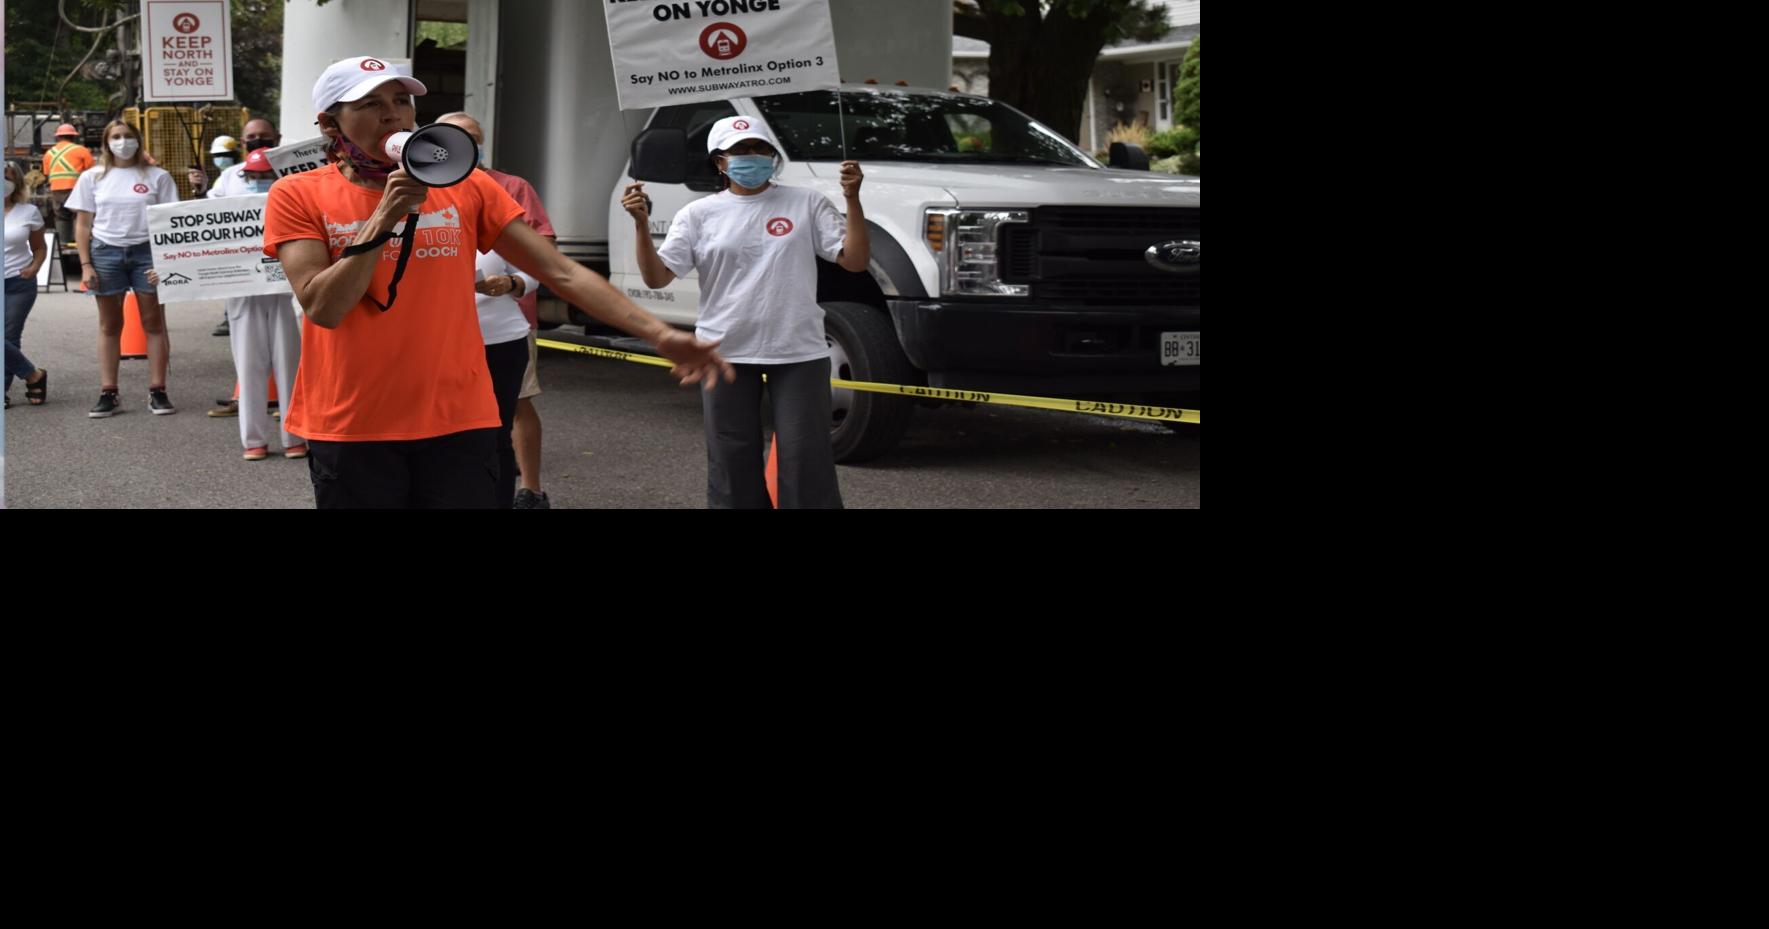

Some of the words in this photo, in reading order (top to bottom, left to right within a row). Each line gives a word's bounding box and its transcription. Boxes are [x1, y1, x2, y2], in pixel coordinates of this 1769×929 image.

[653, 4, 691, 22] ON
[699, 0, 780, 17] YONGE
[162, 36, 212, 49] KEEP
[163, 50, 213, 60] NORTH
[163, 68, 190, 77] STAY
[194, 67, 213, 76] ON
[630, 73, 654, 85] Say
[658, 71, 680, 82] NO
[684, 70, 697, 80] to
[701, 65, 763, 78] Metrolinx
[767, 60, 812, 72] Option
[816, 56, 824, 66] 3
[164, 77, 214, 86] YONGE
[668, 76, 791, 95] WWW.SUBWAYATRO.COM
[170, 215, 204, 228] STOP
[206, 208, 262, 225] SUBWAY
[154, 230, 199, 246] UNDER
[201, 227, 231, 241] OUR
[422, 228, 462, 245] 10K
[163, 253, 177, 261] Say
[178, 251, 192, 259] NO
[202, 248, 239, 257] Metrolinx
[416, 246, 458, 258] OOCH
